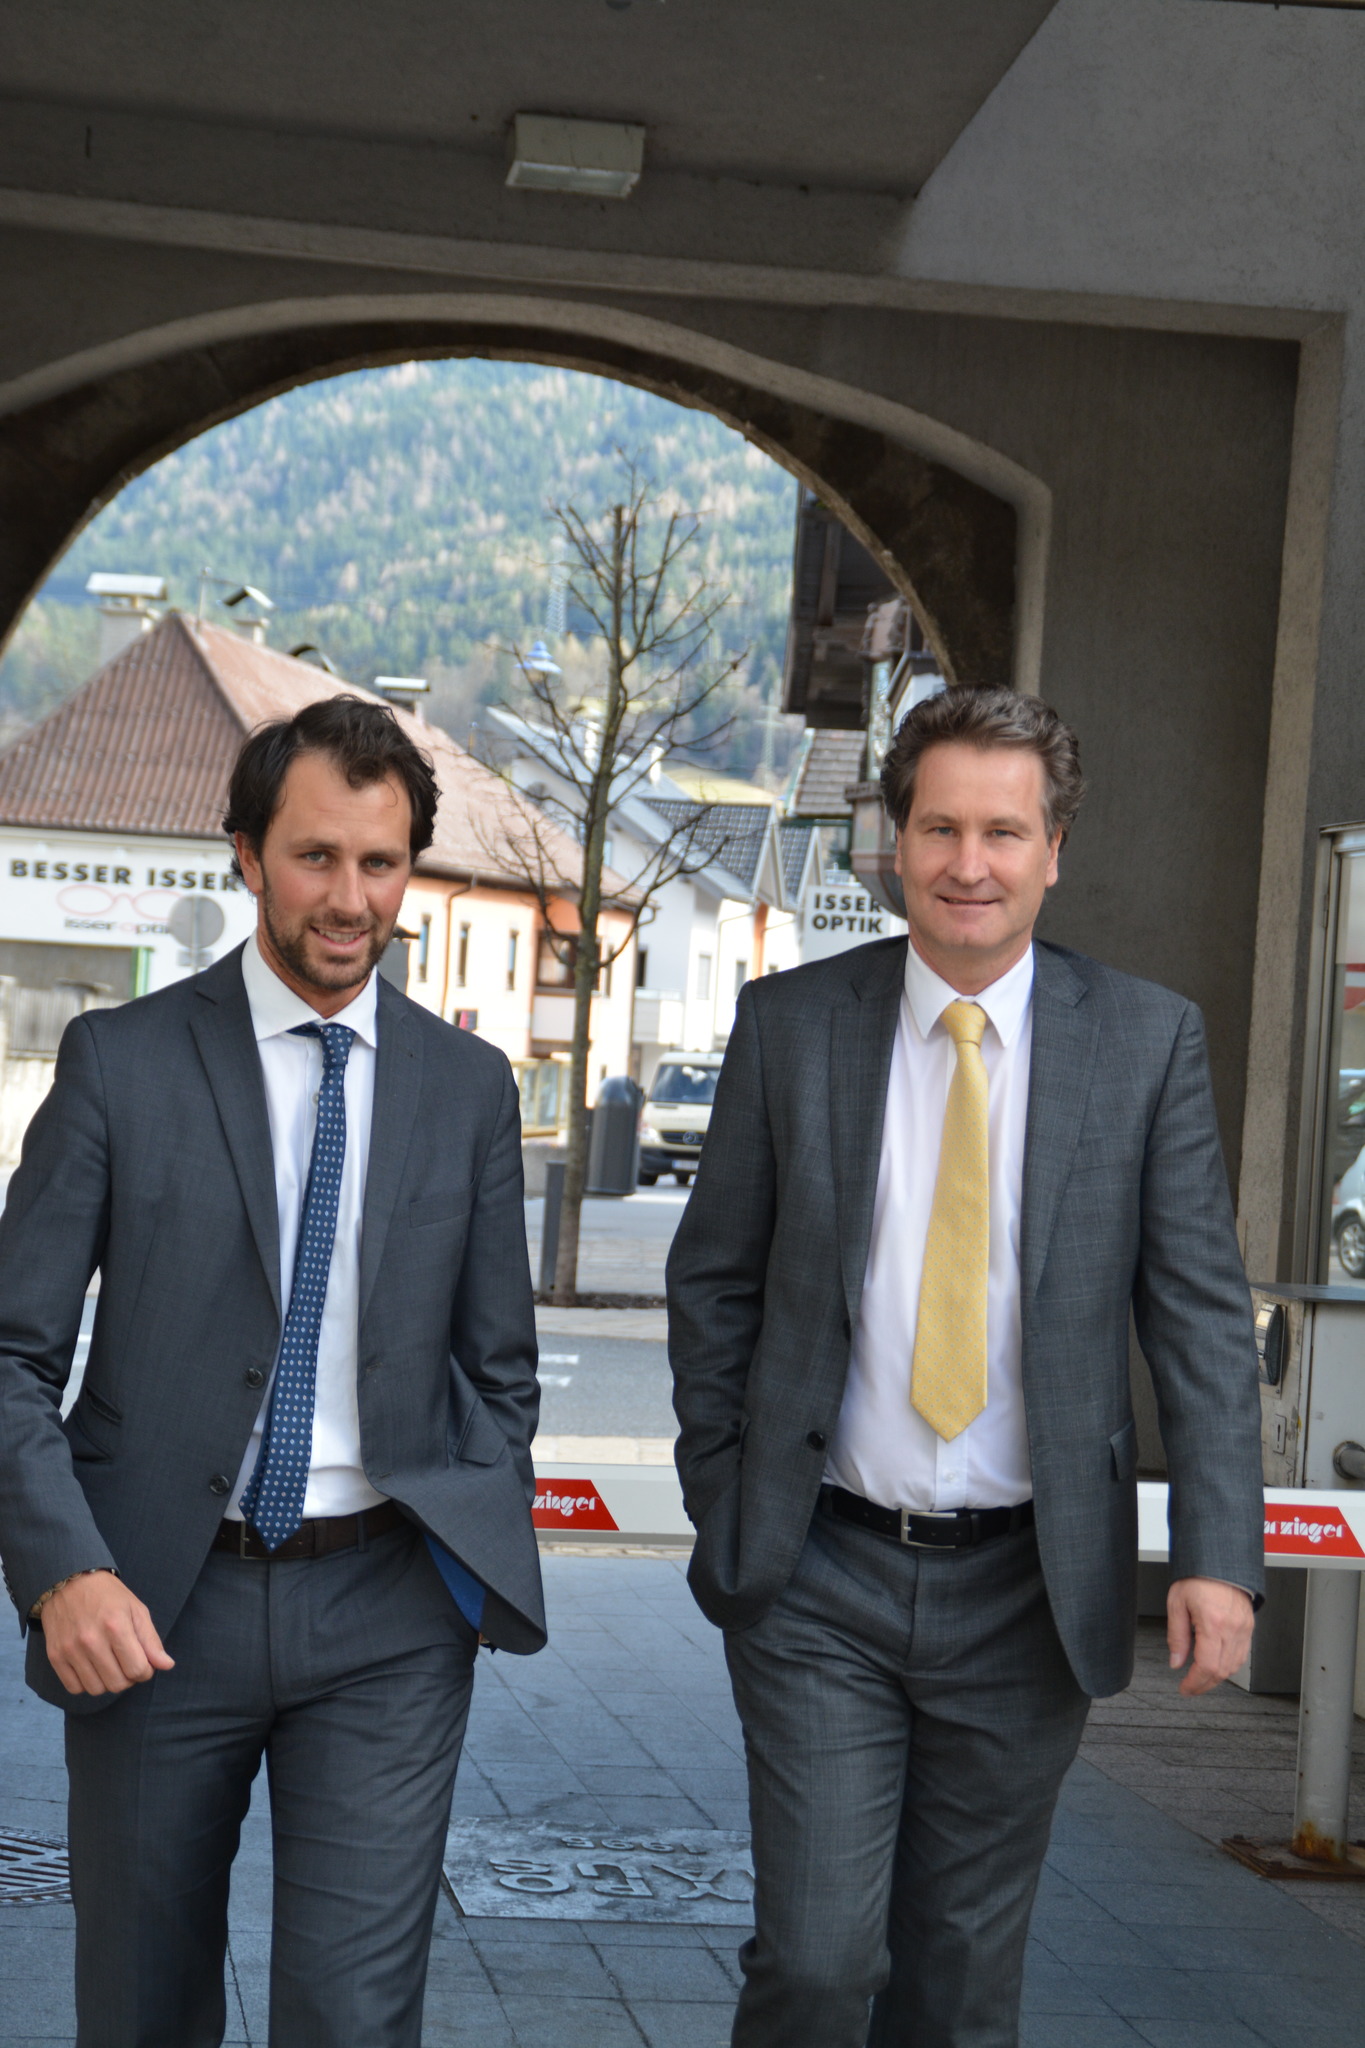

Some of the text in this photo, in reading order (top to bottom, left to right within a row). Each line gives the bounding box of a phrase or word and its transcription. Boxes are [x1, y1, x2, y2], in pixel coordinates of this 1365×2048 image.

[10, 859, 240, 892] BESSER ISSER
[814, 893, 882, 913] ISSER
[812, 913, 882, 934] OPTIK
[561, 1835, 707, 1855] 1995
